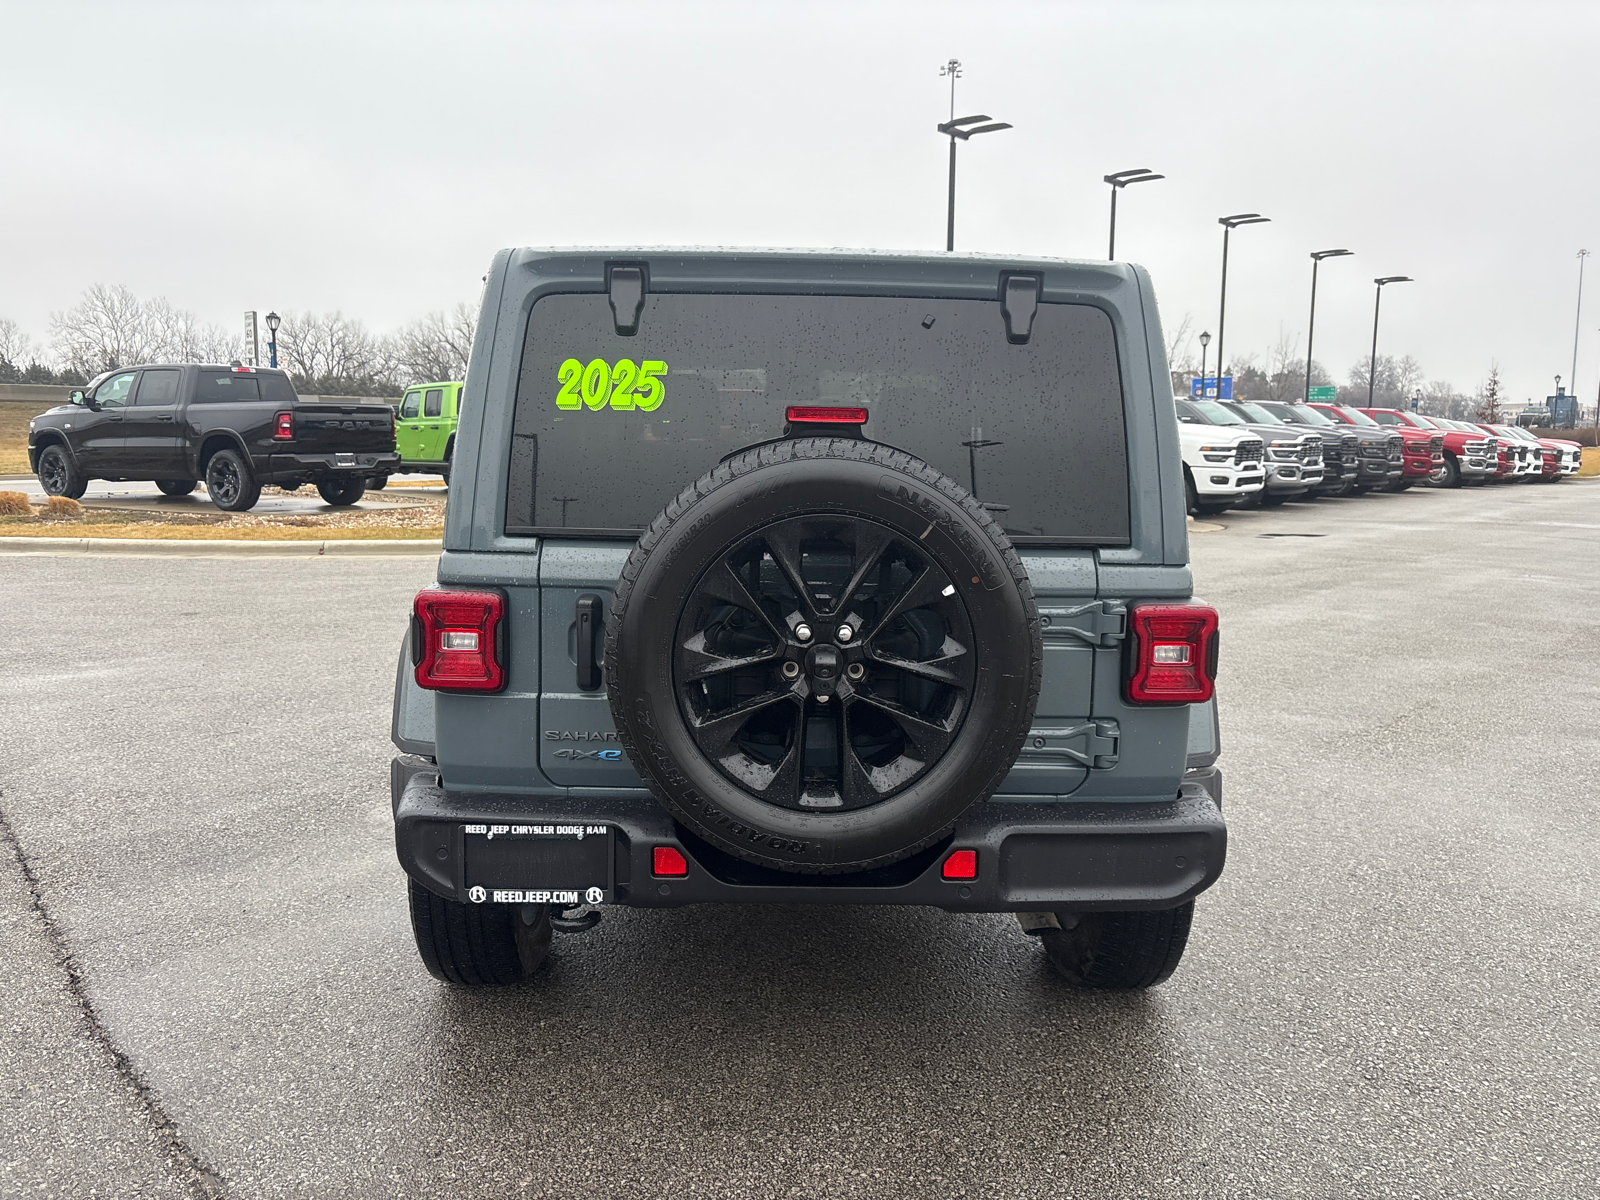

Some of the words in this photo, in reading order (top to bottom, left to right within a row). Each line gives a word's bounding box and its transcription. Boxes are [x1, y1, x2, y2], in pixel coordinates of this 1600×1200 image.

[556, 358, 668, 412] 2025
[325, 421, 371, 430] RAM
[894, 484, 995, 574] NEXEN
[544, 730, 619, 742] SAHAR
[682, 788, 810, 854] ROADIAN
[465, 825, 487, 834] REED
[489, 825, 510, 834] JEEP
[511, 825, 555, 834] CHRYSLER
[556, 826, 584, 834] DODGE
[586, 826, 607, 834] RAM
[493, 891, 579, 903] REEDJEEP.COM
